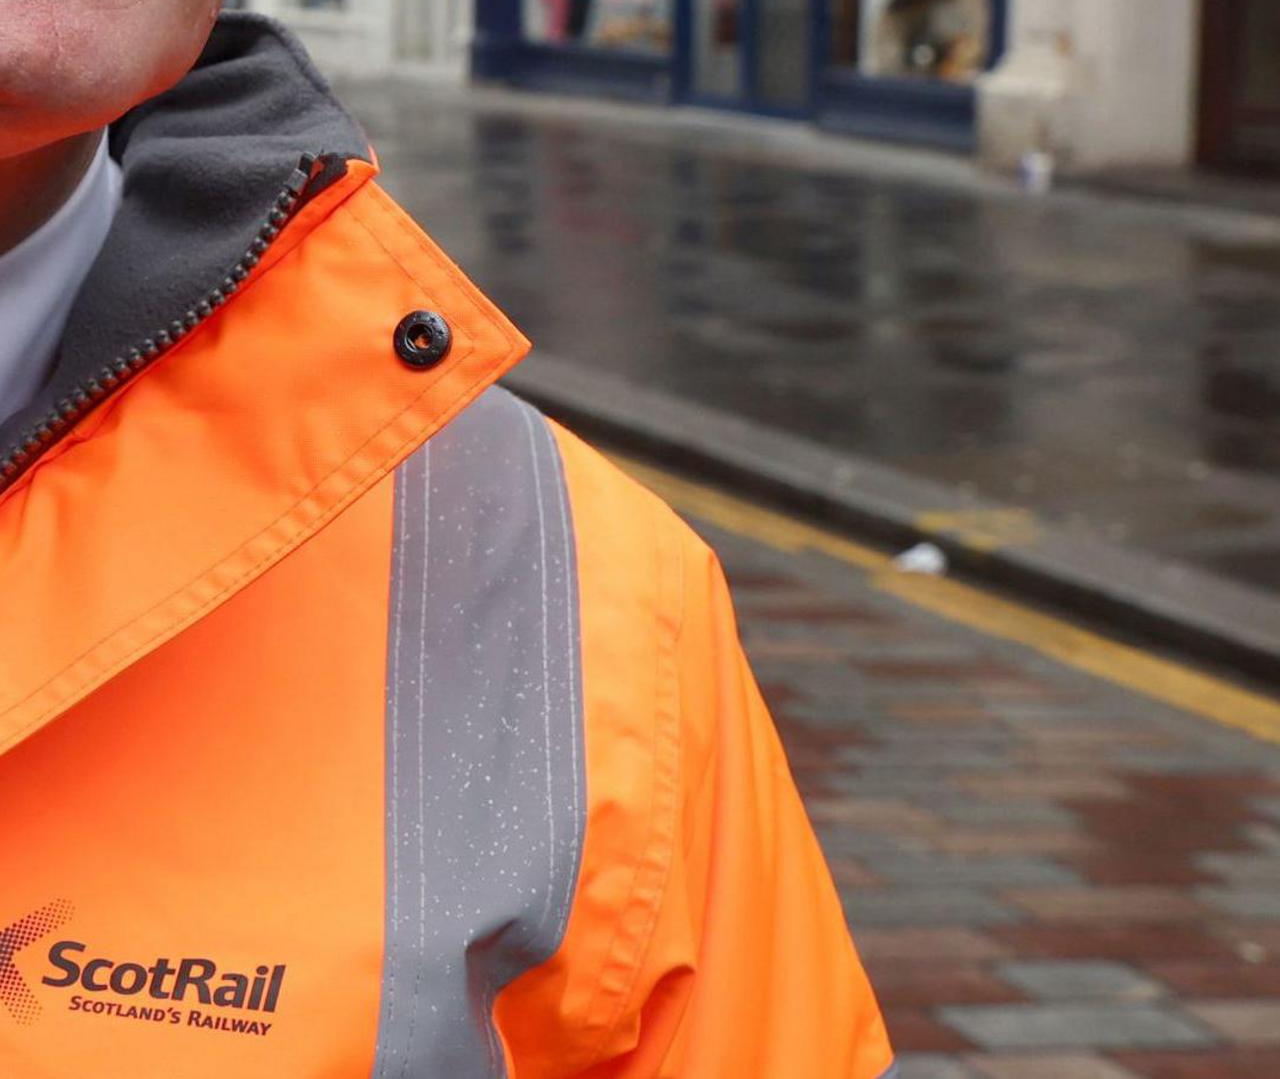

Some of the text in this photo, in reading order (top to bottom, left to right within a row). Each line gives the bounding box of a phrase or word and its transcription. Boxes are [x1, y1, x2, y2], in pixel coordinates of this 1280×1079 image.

[41, 940, 287, 1013] ScotRail
[68, 995, 273, 1037] SCOTLAND'S RAILWAY
